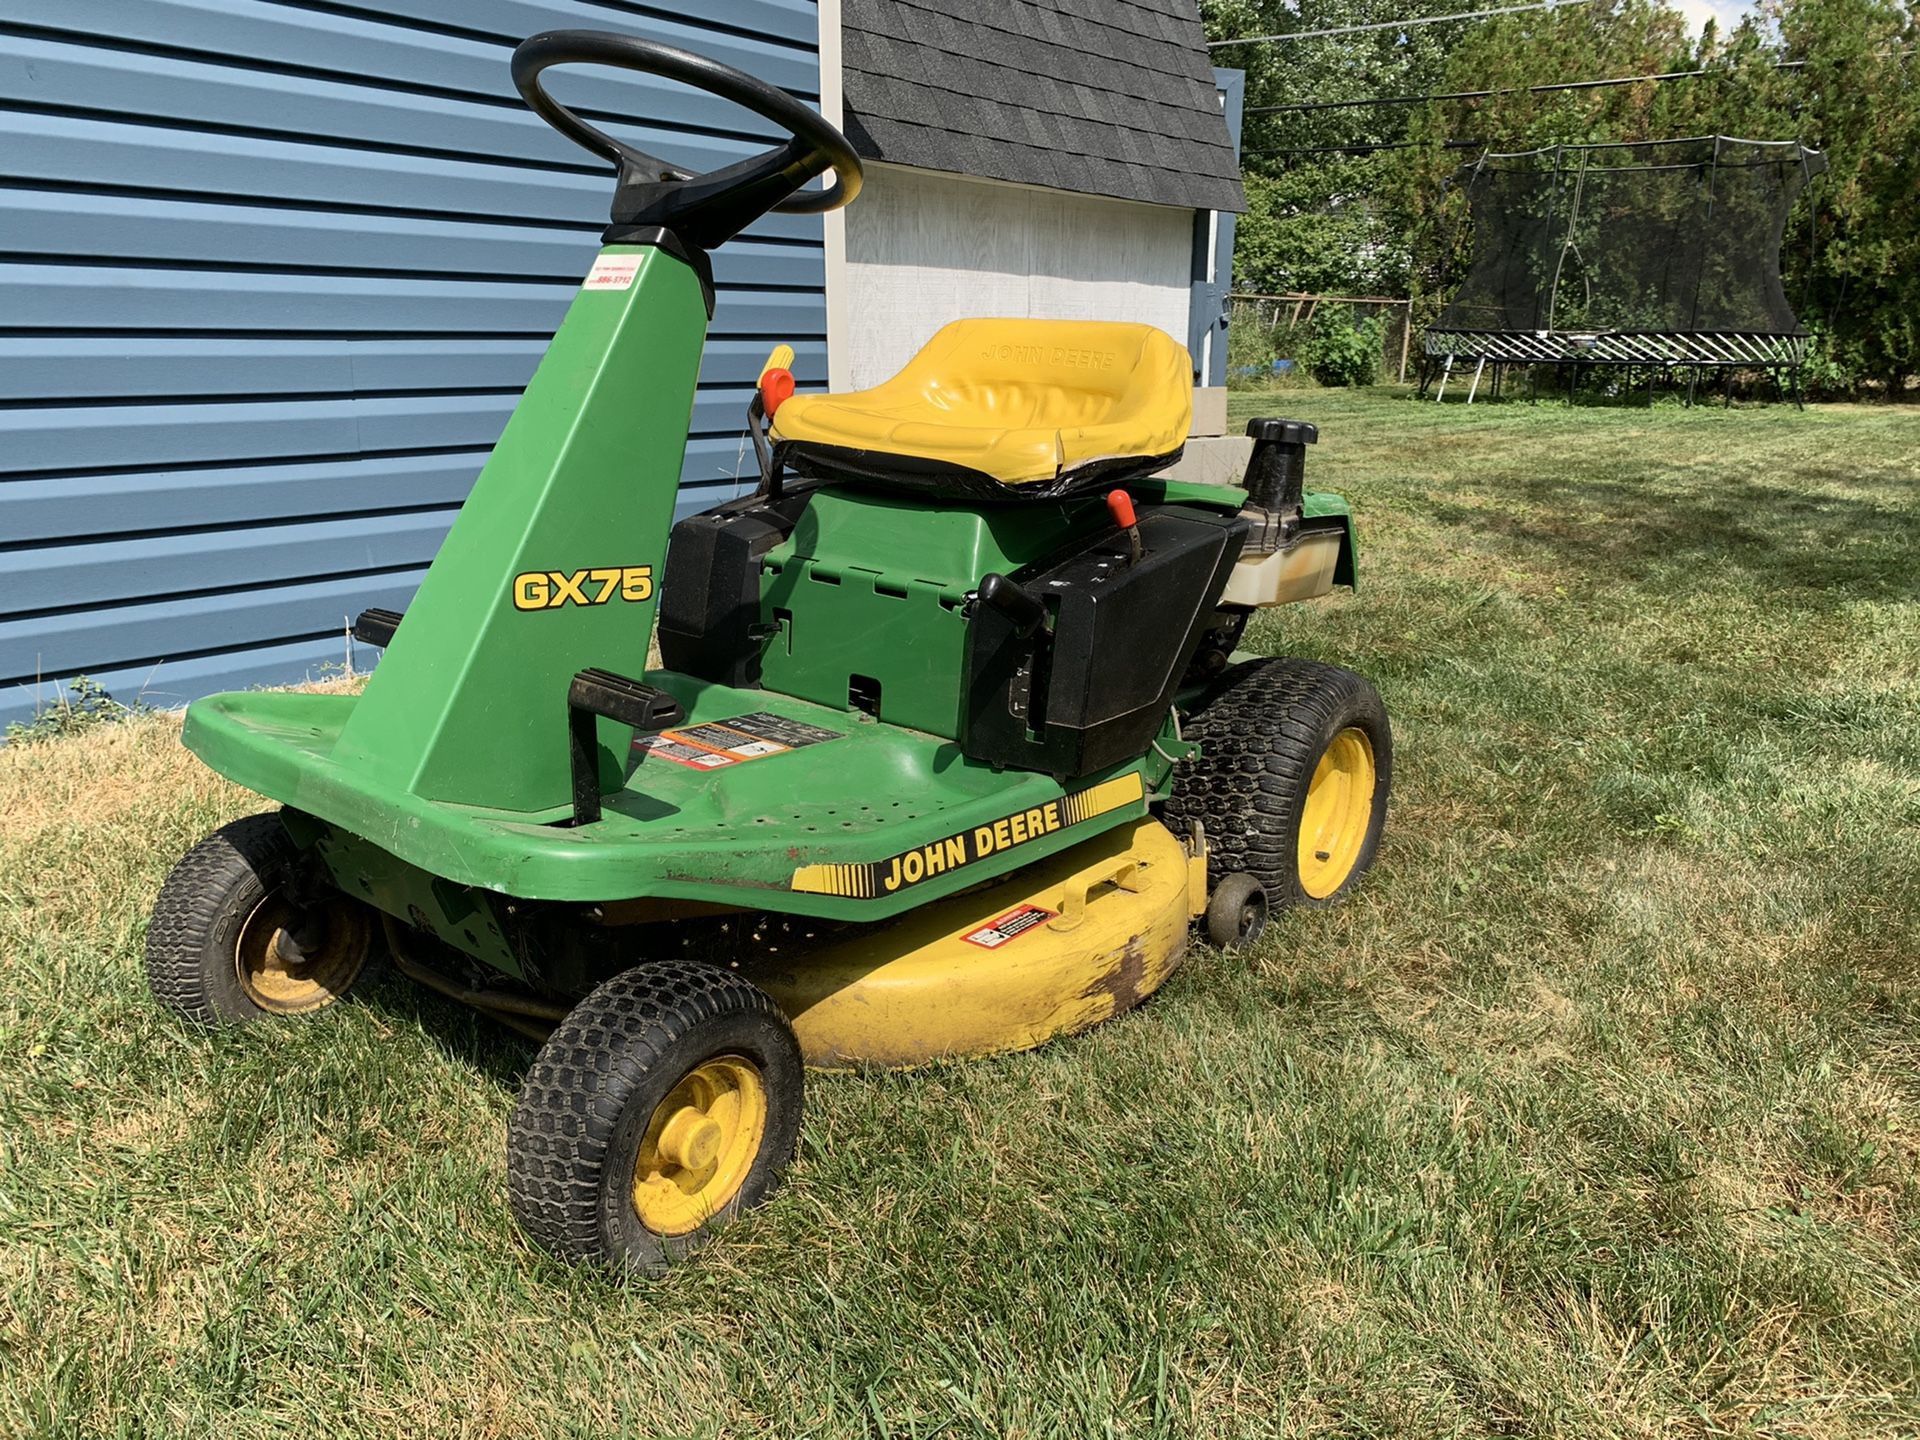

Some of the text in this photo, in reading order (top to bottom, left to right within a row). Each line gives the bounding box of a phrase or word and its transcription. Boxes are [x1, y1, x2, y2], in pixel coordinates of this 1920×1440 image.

[981, 344, 1116, 368] JOHN DEERE
[514, 566, 653, 611] GX75
[884, 803, 1061, 891] JOHN DEERE
